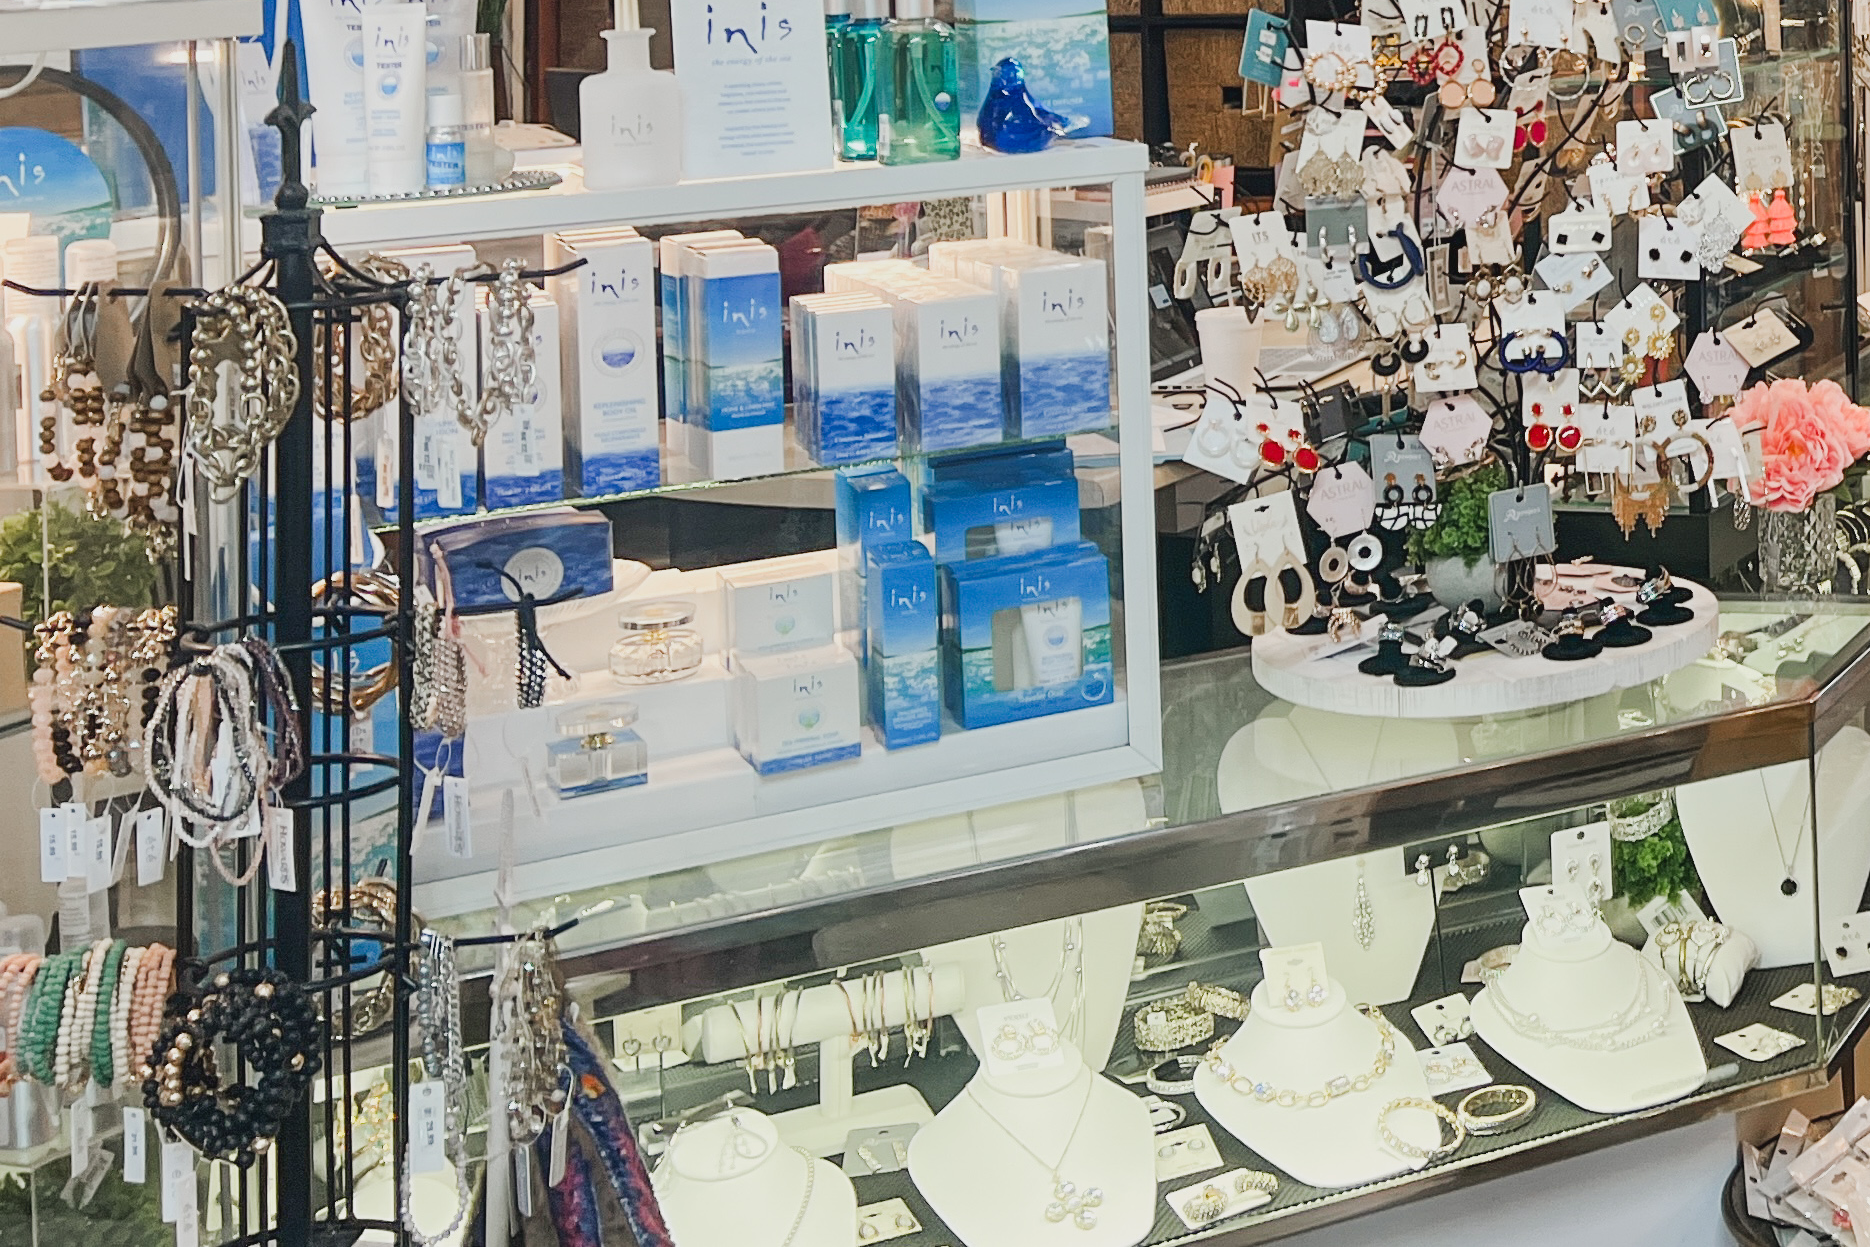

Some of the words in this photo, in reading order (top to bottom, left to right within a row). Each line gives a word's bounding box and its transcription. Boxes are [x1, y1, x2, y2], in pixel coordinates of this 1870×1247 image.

[346, 23, 361, 31] TES
[375, 26, 409, 53] inis
[707, 1, 792, 54] inis
[0, 152, 46, 197] nis
[591, 268, 640, 299] inis
[722, 298, 768, 327] inis
[1043, 288, 1084, 316] inis
[836, 328, 876, 354] inis
[940, 316, 979, 343] inis
[1699, 349, 1739, 363] ASTRA
[993, 495, 1023, 515] inis
[869, 507, 904, 531] inis
[517, 566, 547, 584] inis
[1020, 575, 1050, 597] inis
[769, 586, 799, 603] inis
[891, 585, 927, 610] inis
[793, 675, 824, 695] inis
